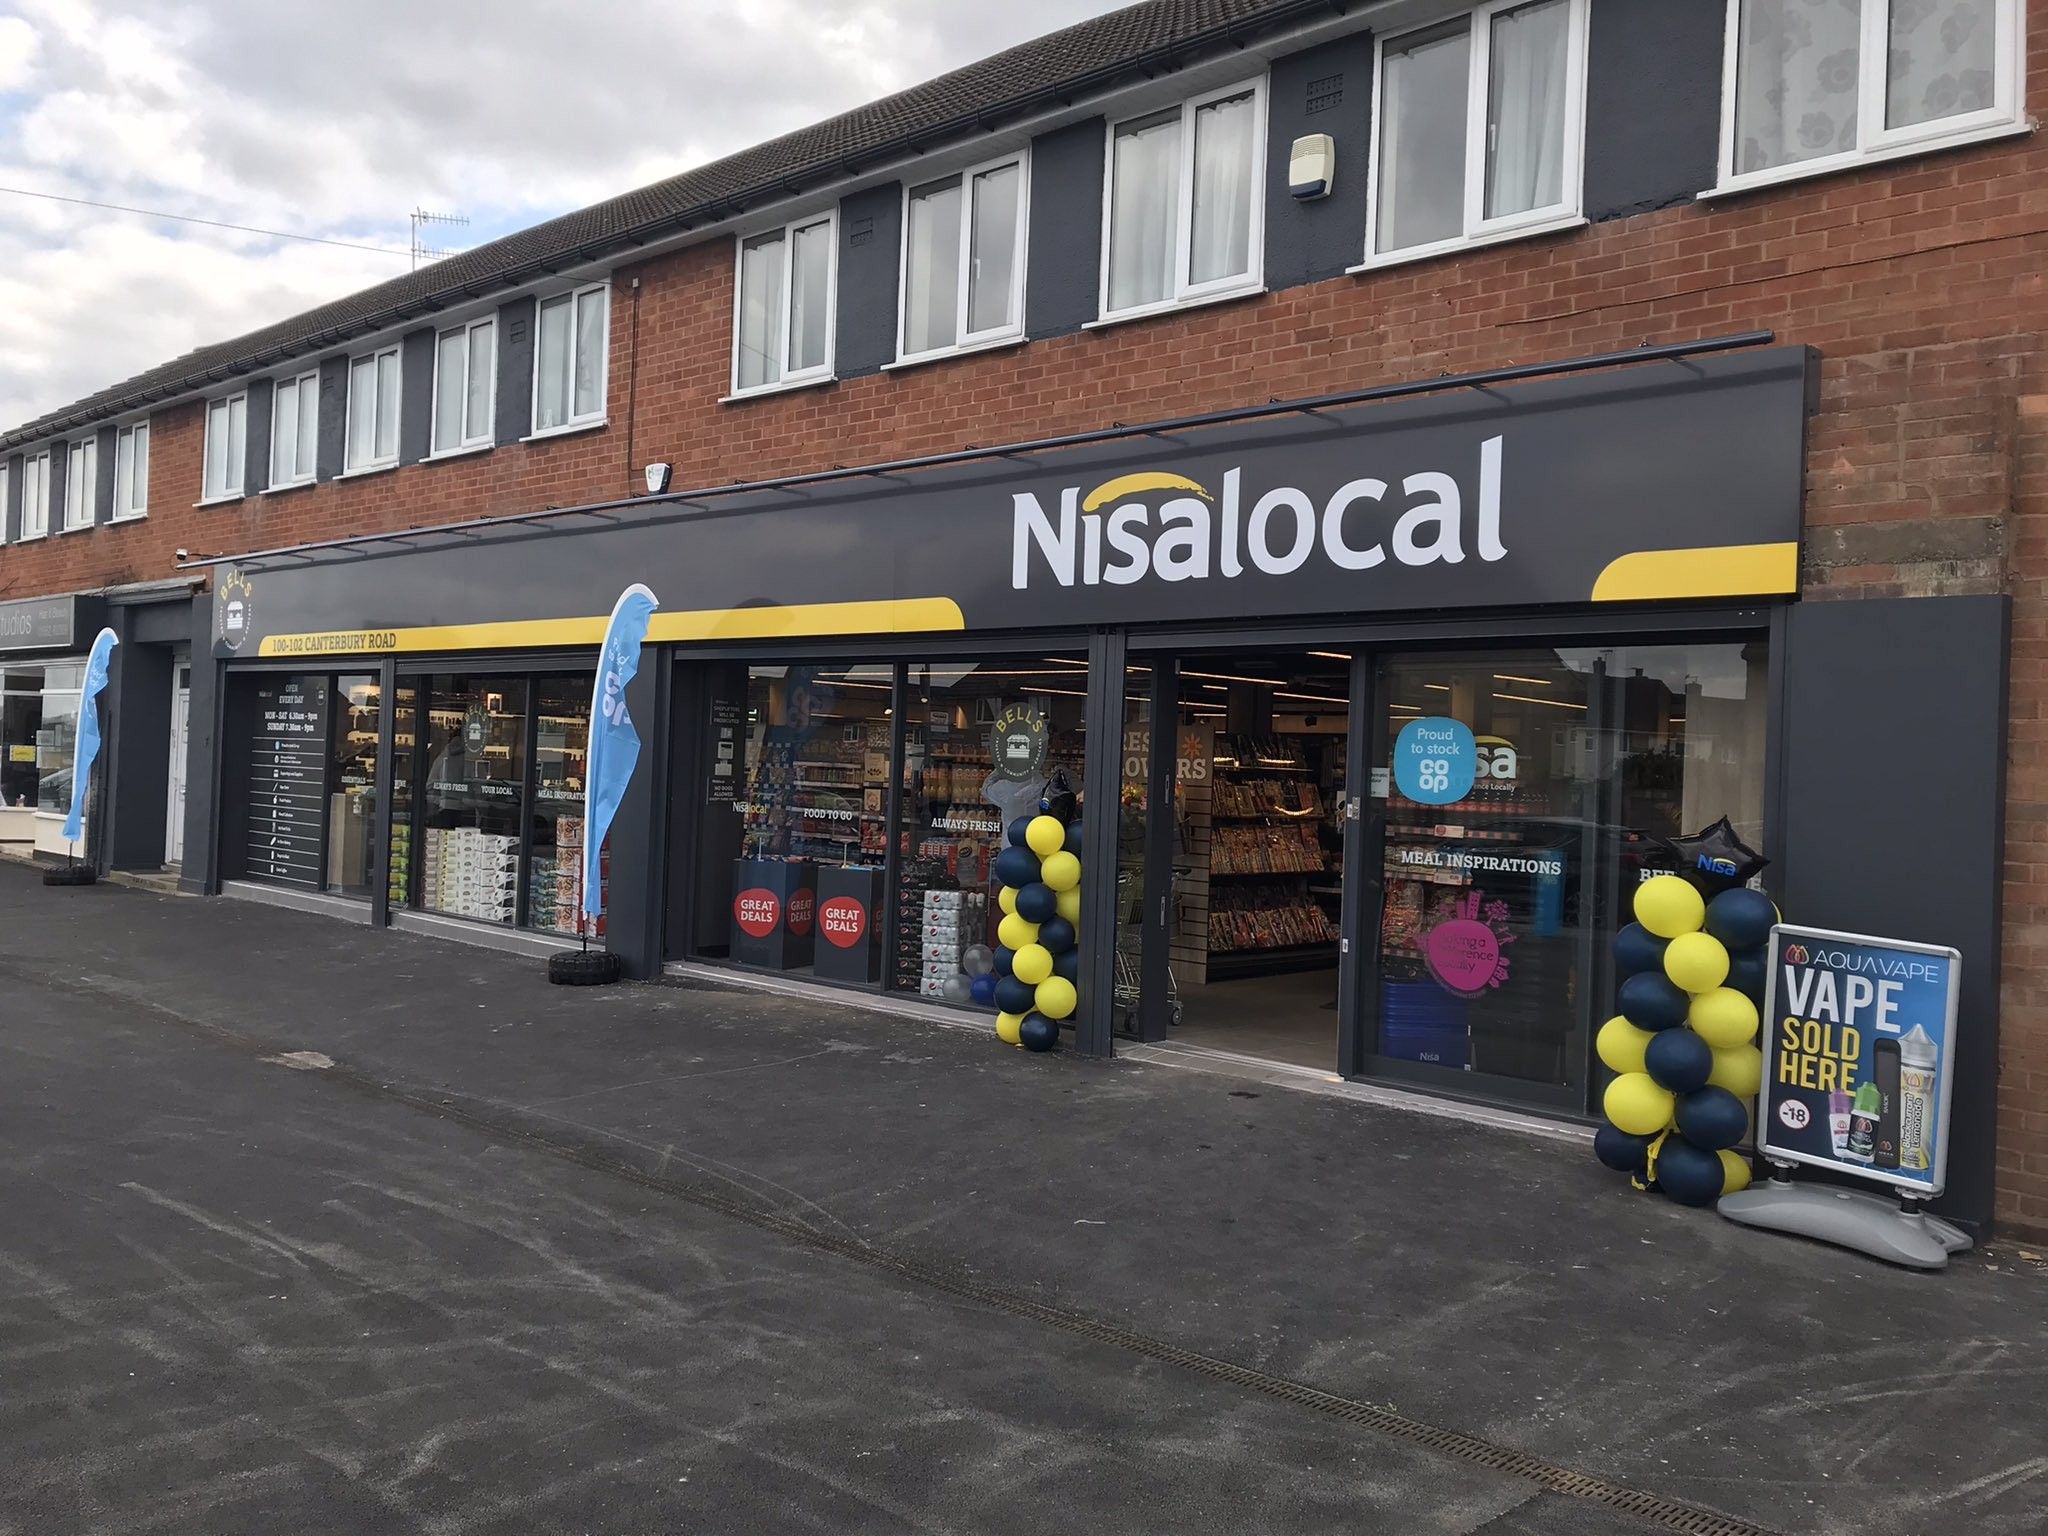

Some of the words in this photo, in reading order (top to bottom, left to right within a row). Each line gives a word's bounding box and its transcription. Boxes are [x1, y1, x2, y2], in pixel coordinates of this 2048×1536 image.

[1011, 434, 1509, 590] Nisalocal
[220, 568, 252, 601] BELLS
[273, 638, 303, 652] 100-102
[305, 634, 367, 651] CANTERBURY
[368, 632, 397, 649] ROAD
[996, 706, 1043, 733] BELLS
[1417, 727, 1454, 741] Proud
[1411, 743, 1423, 754] to
[1427, 742, 1460, 756] stock
[481, 785, 495, 794] YOUR
[496, 787, 513, 796] LOCAL
[538, 789, 553, 798] MEAL
[554, 790, 585, 801] INSPIRATIO
[1490, 783, 1516, 793] Locally
[803, 809, 827, 819] FOOD
[827, 810, 838, 820] TO
[840, 811, 853, 821] GO
[931, 817, 968, 830] ALWAYS
[969, 820, 1000, 832] FRESH
[1401, 850, 1443, 866] MEAL
[1447, 853, 1562, 875] INSPIRATIONS
[1697, 854, 1738, 877] Nisa
[740, 899, 774, 911] GREAT
[790, 899, 812, 911] GREAT
[740, 911, 773, 923] DEALS
[790, 911, 811, 923] DEALS
[825, 908, 859, 921] GREAT
[826, 920, 858, 933] DEALS
[1813, 950, 1939, 984] AQUAVAPE
[1785, 964, 1904, 1034] VAPE
[1782, 1016, 1860, 1062] SOLD
[1419, 1052, 1440, 1062] Nisa
[1779, 1050, 1859, 1098] HERE
[1902, 1091, 1914, 1148] Blackcurrant
[1911, 1097, 1923, 1149] Lemonade
